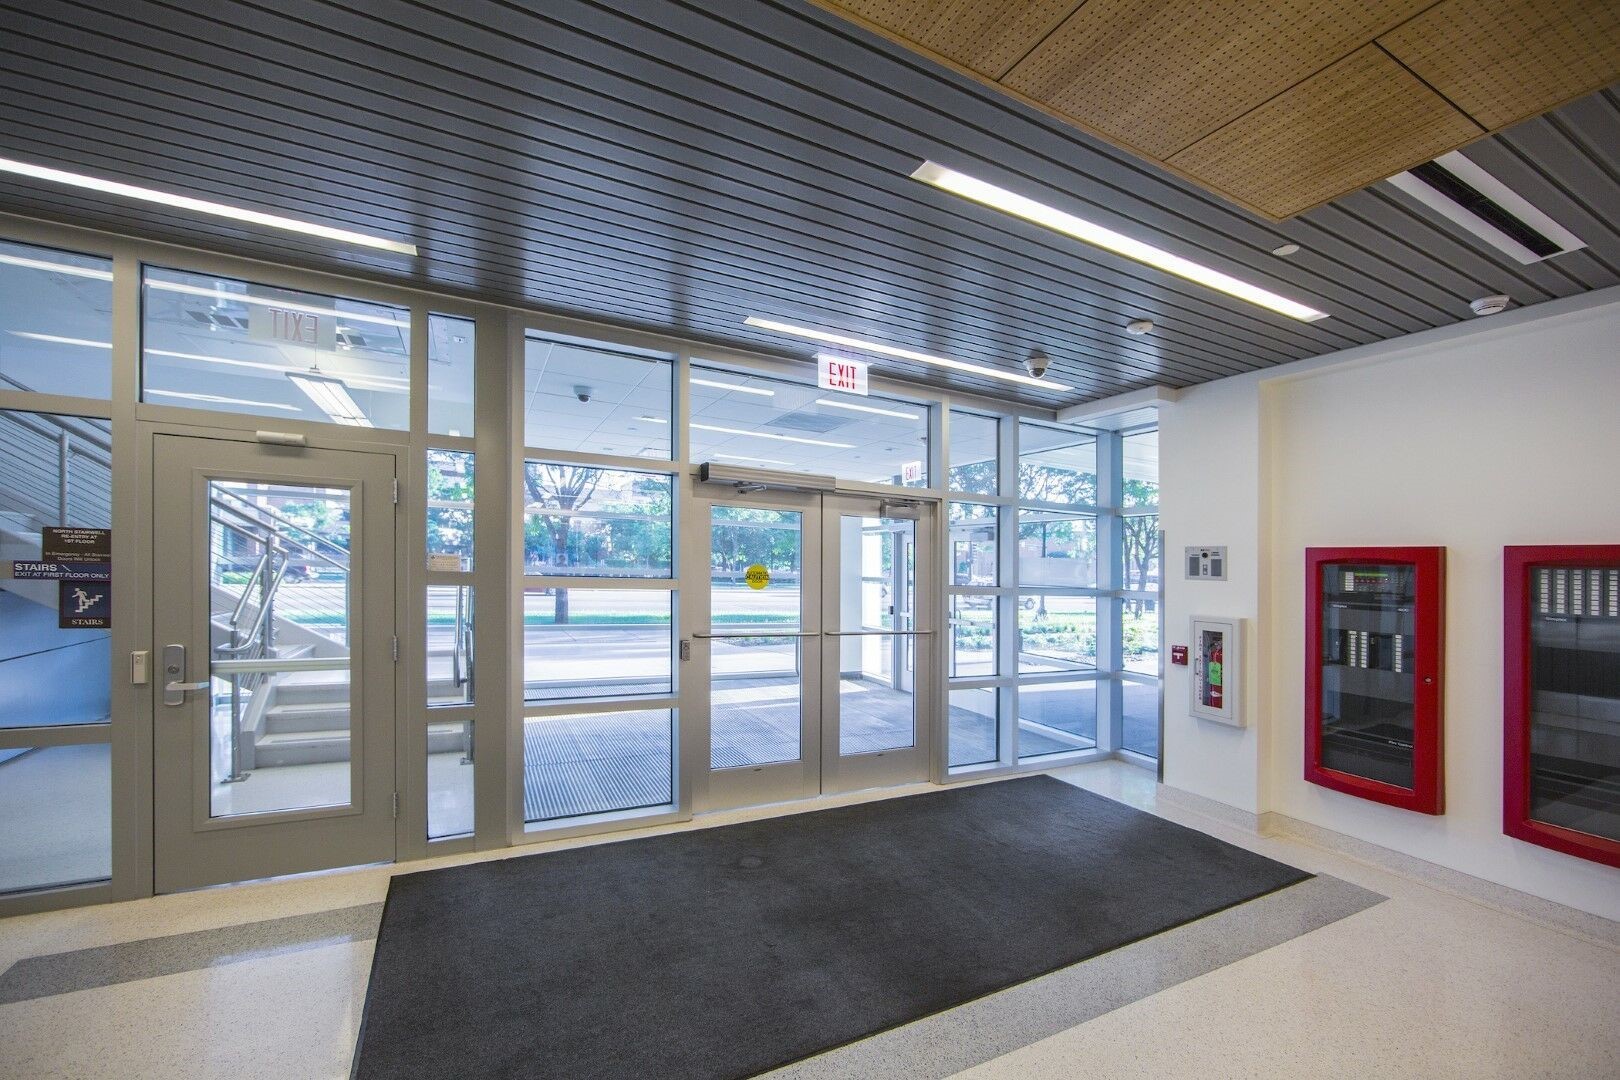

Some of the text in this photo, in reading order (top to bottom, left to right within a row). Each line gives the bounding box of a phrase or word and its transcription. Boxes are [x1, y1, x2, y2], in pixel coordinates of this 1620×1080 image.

[829, 361, 857, 390] EXIT
[905, 465, 917, 481] EXIT
[15, 563, 58, 572] STAIRS
